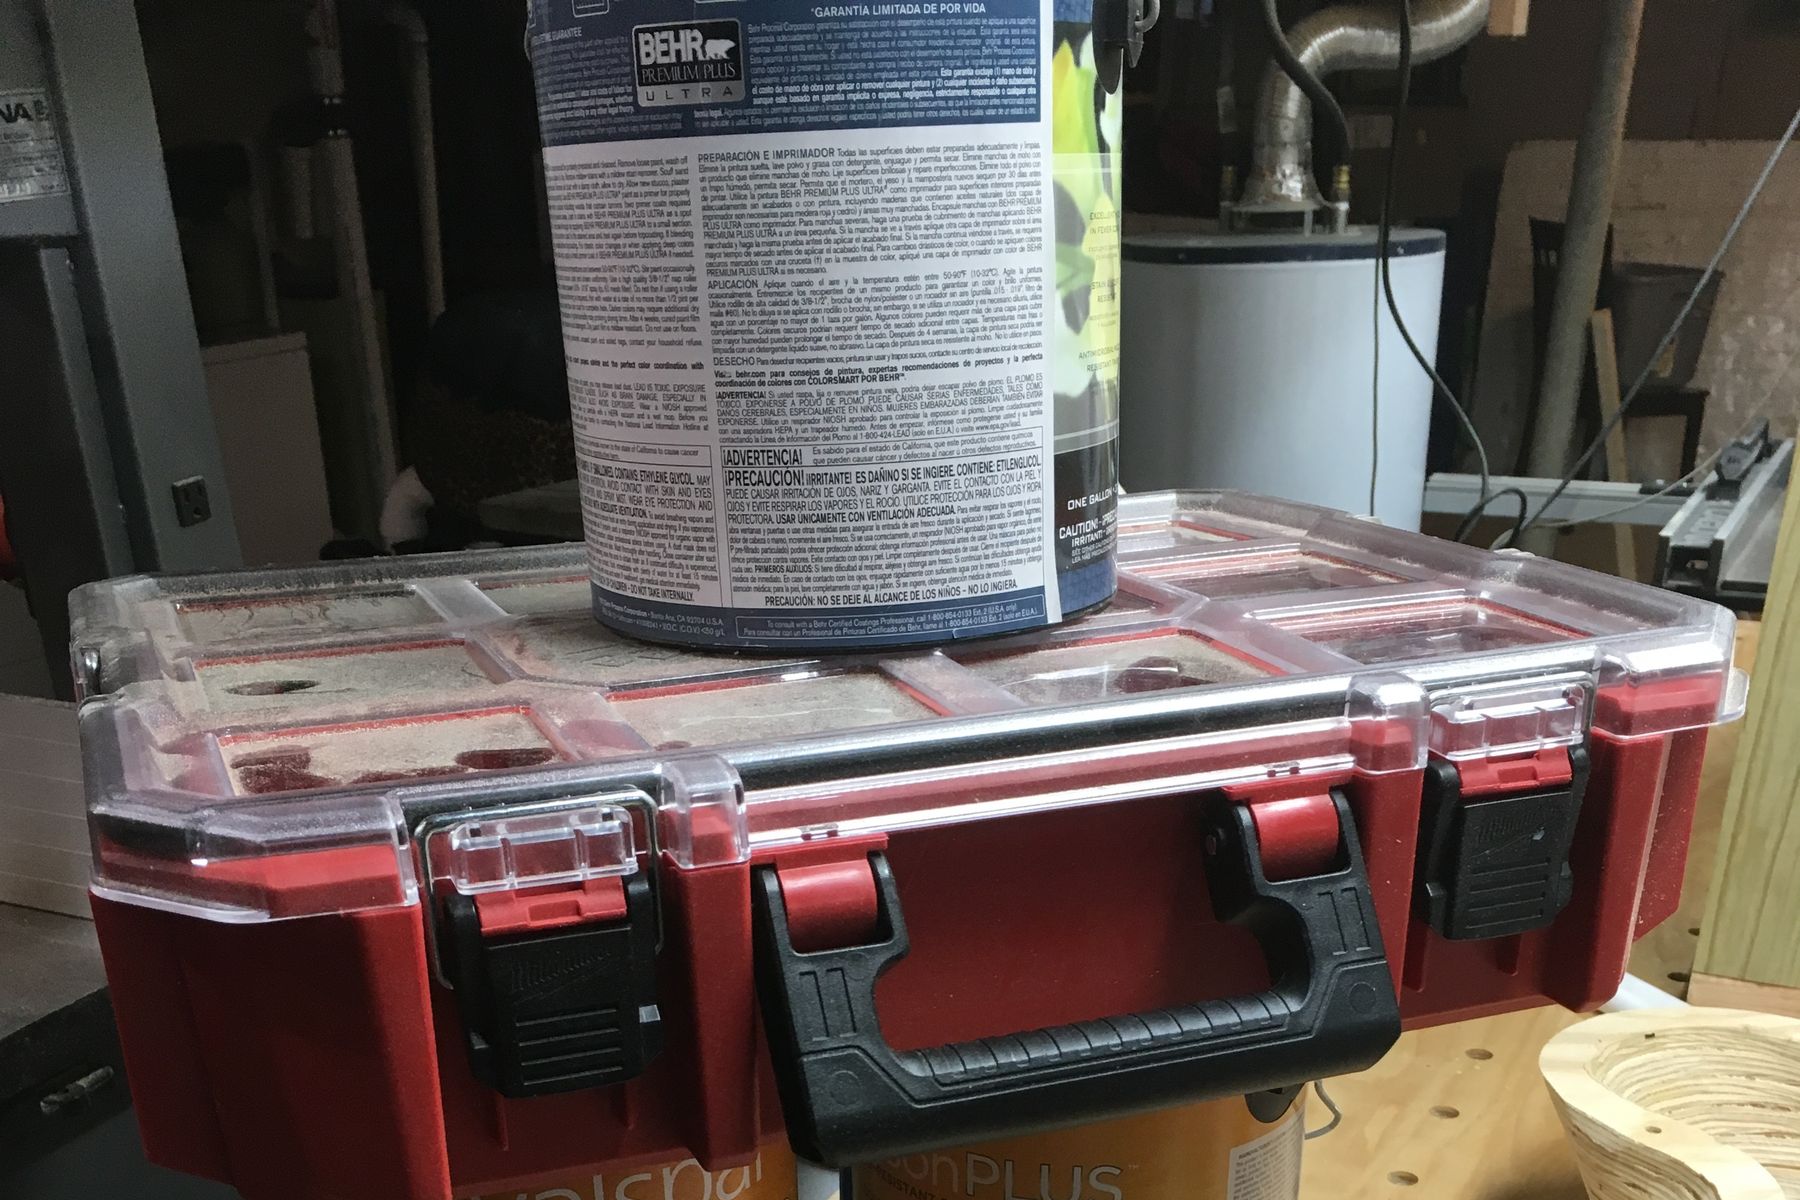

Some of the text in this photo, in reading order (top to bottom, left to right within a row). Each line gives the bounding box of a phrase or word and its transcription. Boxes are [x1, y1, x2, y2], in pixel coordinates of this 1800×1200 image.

[873, 4, 920, 15] LIMITADA
[924, 4, 937, 14] DE
[940, 3, 961, 13] POR
[963, 3, 986, 13] VIDA
[638, 29, 706, 65] BEHR
[642, 62, 735, 83] PREMIUM PLUS
[646, 86, 733, 101] ULTRA
[698, 148, 835, 163] PREPARACIÓN E IMPRIMADOR
[708, 278, 758, 290] APLICACIÓN
[714, 356, 755, 366] DESECHO
[723, 449, 802, 466] ¡ADVERTENCIA!
[725, 467, 804, 487] ¡PRECAUCIÓN!
[856, 471, 866, 484] ES
[868, 466, 900, 482] DAÑINO
[901, 469, 909, 481] SI
[911, 468, 922, 480] SE
[726, 489, 748, 499] PUEDE
[751, 488, 779, 499] CAUSAR
[782, 485, 821, 498] IRRITACIÓN
[824, 487, 834, 498] DE
[860, 486, 881, 496] NARIZ
[884, 485, 889, 494] Y
[934, 479, 952, 491] EVITE
[954, 479, 962, 489] EL
[964, 476, 998, 489] CONTACTO
[1001, 473, 1014, 485] CON
[1017, 472, 1024, 481] LA
[1025, 470, 1036, 481] PIEL
[1037, 469, 1041, 477] Y
[727, 501, 744, 512] OJOS
[746, 501, 750, 510] Y
[752, 501, 770, 511] EVITE
[772, 500, 806, 511] RESPIRAR
[808, 500, 822, 510] LOS
[823, 499, 858, 510] VAPORES
[860, 499, 864, 508] Y
[866, 498, 874, 509] EL
[903, 493, 928, 506] UTILICE
[930, 488, 974, 504] PROTECCIÓN
[975, 488, 992, 498] PARA
[993, 486, 1005, 497] LOS
[1006, 484, 1021, 496] OJOS
[1023, 483, 1026, 492] Y
[1027, 481, 1041, 492] ROPA
[1067, 489, 1112, 511] ONE GALLON
[776, 514, 796, 524] USAR
[798, 511, 846, 524] ÚNICAMENTE
[849, 512, 865, 523] CON
[867, 506, 915, 521] VENTILACIÓN
[1059, 518, 1098, 539] CAUTION!
[764, 593, 815, 607] PRECAUCIÓN:
[817, 596, 828, 605] NO
[830, 596, 841, 605] SE
[843, 595, 861, 604] DEJE
[864, 594, 873, 604] AL
[874, 591, 908, 603] ALCANCE
[910, 591, 920, 600] DE
[922, 590, 937, 599] LOS
[938, 585, 961, 598] NIÑOS
[968, 585, 980, 594] NO
[981, 584, 989, 593] LO
